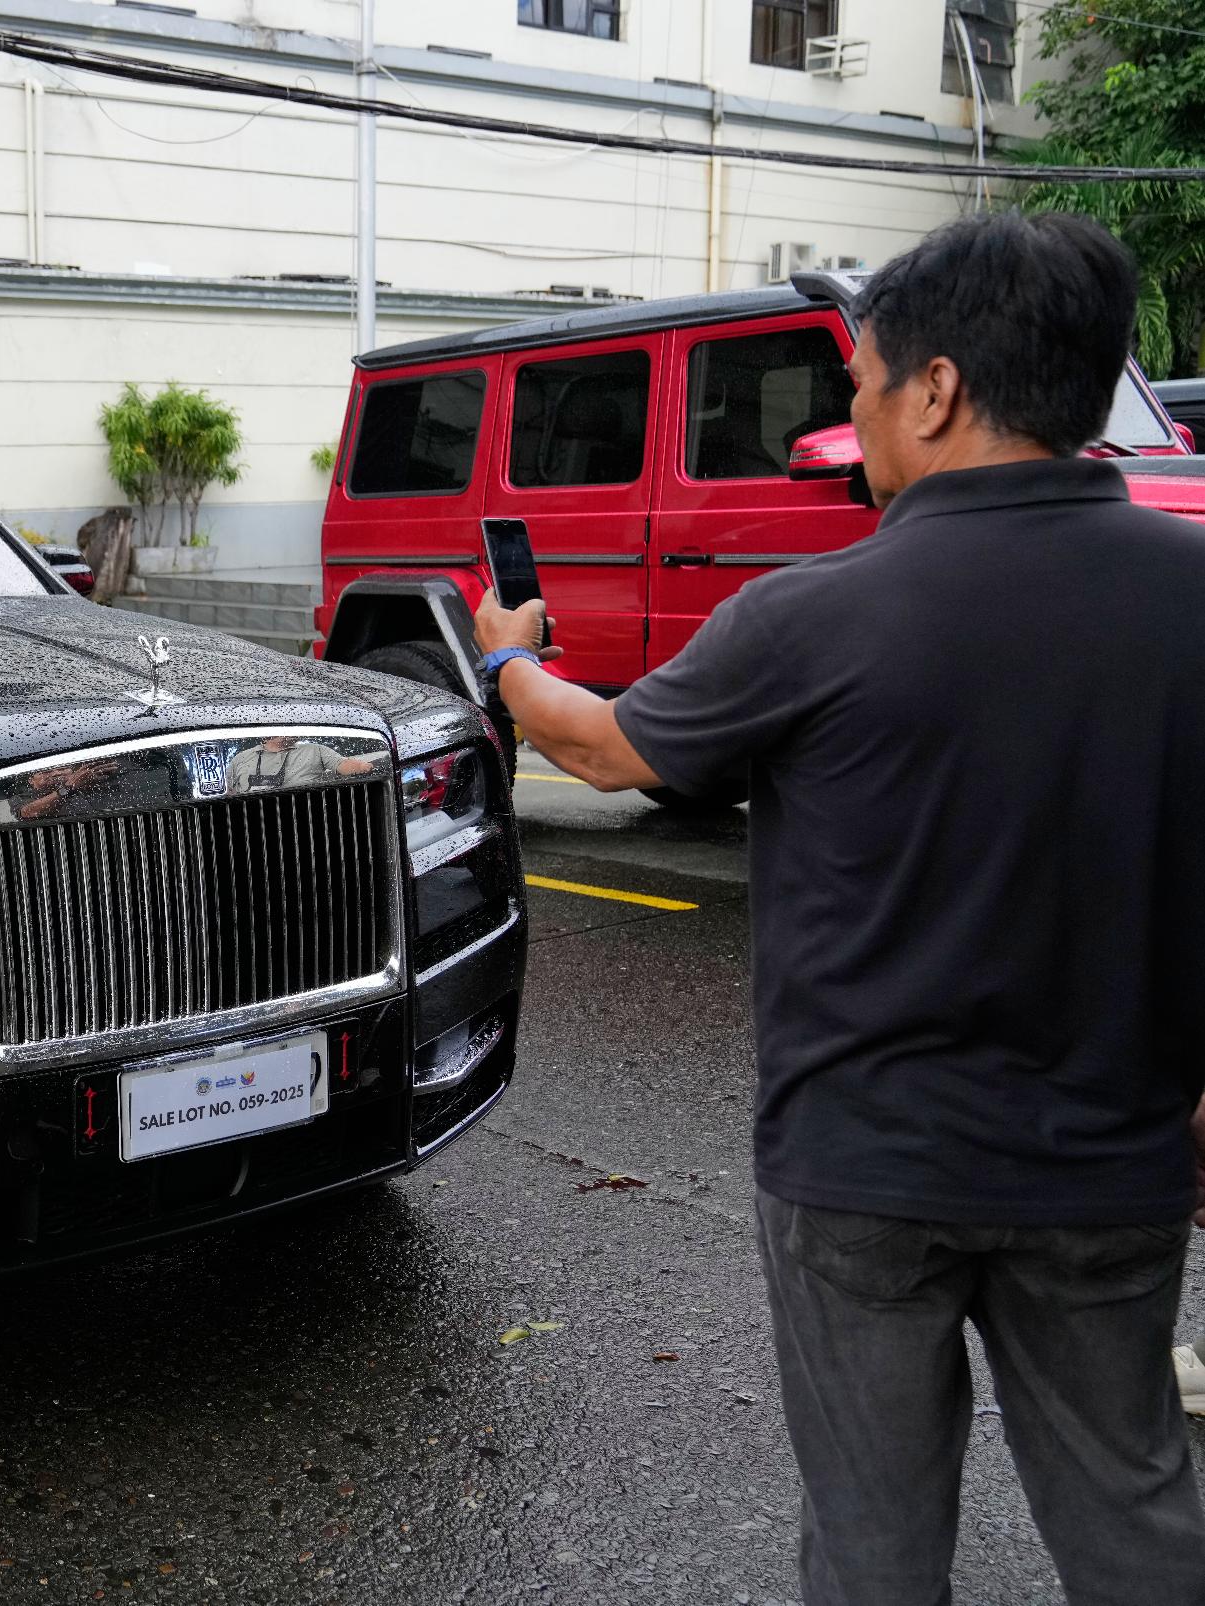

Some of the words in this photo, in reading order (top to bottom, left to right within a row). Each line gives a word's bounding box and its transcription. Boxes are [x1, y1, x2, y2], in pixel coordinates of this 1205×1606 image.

[139, 1111, 175, 1131] SALE
[178, 1105, 206, 1124] LOT
[209, 1100, 235, 1117] NO.
[238, 1084, 304, 1111] 059-2025
